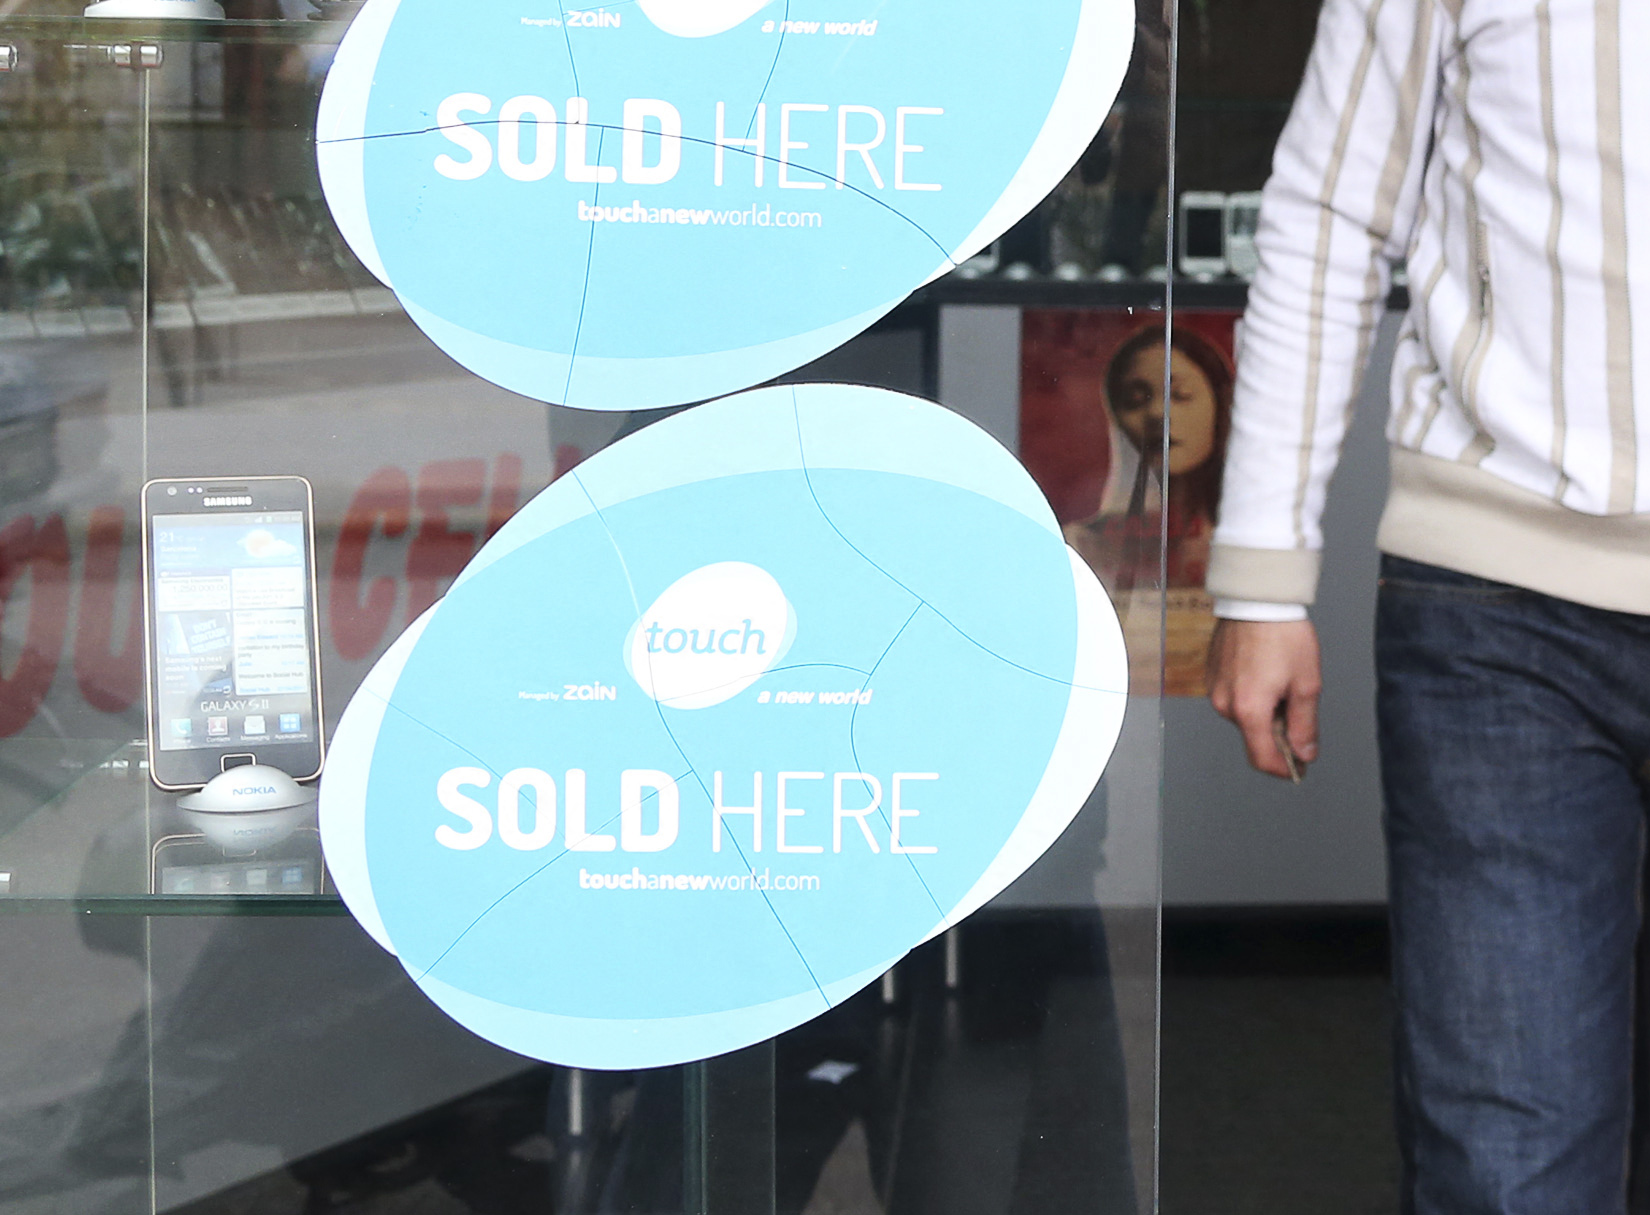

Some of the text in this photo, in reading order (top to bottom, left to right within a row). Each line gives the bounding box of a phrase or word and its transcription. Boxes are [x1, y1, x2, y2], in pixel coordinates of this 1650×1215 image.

[761, 19, 878, 36] a new world
[433, 91, 945, 192] SOLD HERE
[577, 200, 822, 229] touchanewworld.com
[203, 496, 252, 507] SAMSUNG
[644, 619, 766, 655] touch
[201, 700, 246, 712] GALAXY
[757, 689, 873, 705] a new world
[232, 786, 277, 796] NOKIA
[435, 766, 940, 856] SOLD HERE
[579, 867, 820, 893] touchanewworld.com
